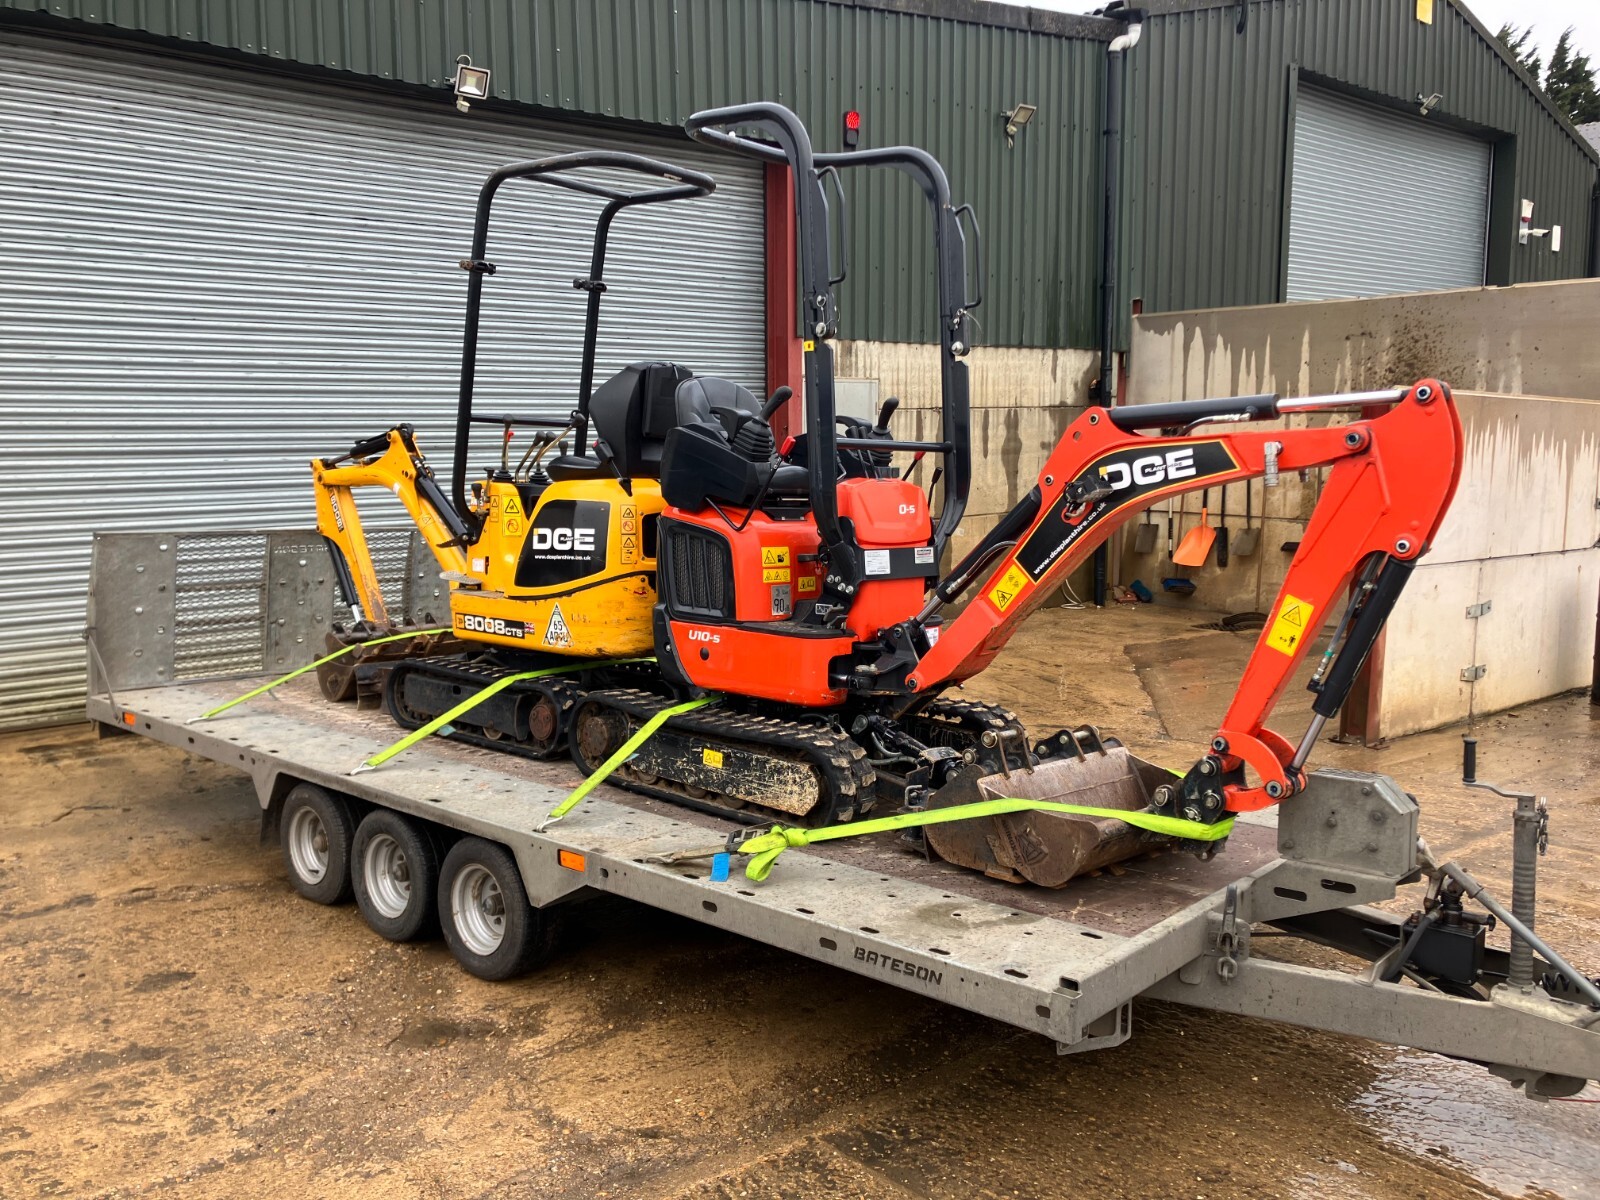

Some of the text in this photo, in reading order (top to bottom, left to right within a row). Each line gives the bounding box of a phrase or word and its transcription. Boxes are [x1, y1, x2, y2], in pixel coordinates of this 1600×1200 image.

[1099, 448, 1197, 491] DCE
[532, 527, 596, 551] DCE
[1033, 501, 1107, 575] www.dceplanthire.co.uk
[853, 946, 943, 986] BATESON
